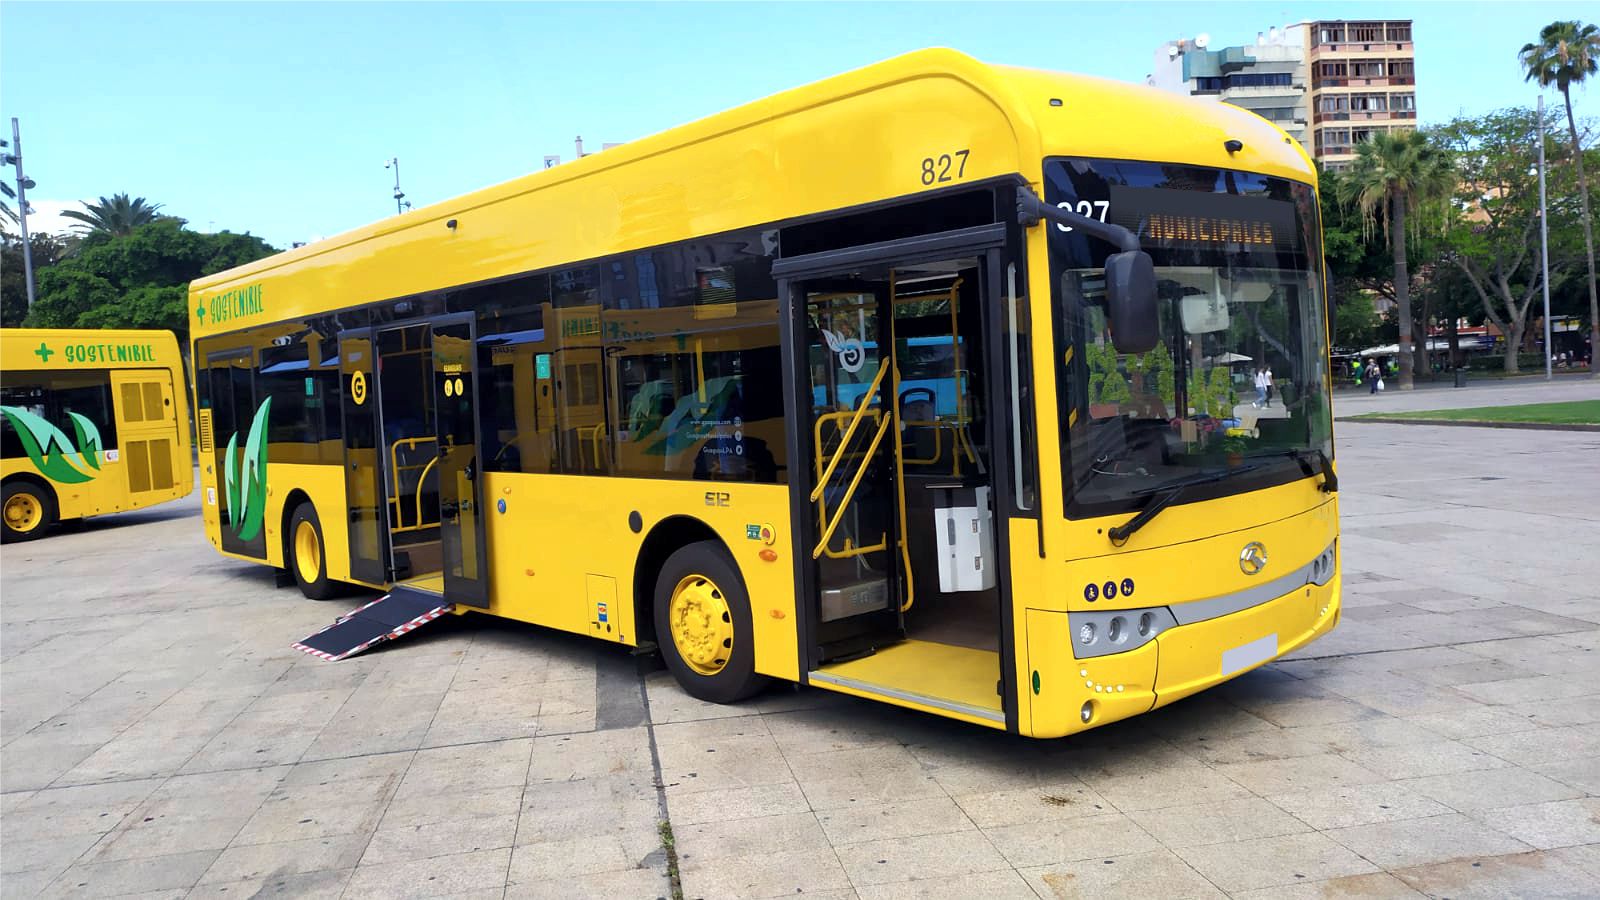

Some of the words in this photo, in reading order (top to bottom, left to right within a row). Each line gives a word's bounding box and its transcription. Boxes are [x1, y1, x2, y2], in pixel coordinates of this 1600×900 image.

[921, 149, 970, 185] 827
[1150, 214, 1272, 243] MUNICIPALES
[210, 283, 264, 325] SOSTENIBLE
[65, 344, 157, 362] SOSTENIBLE
